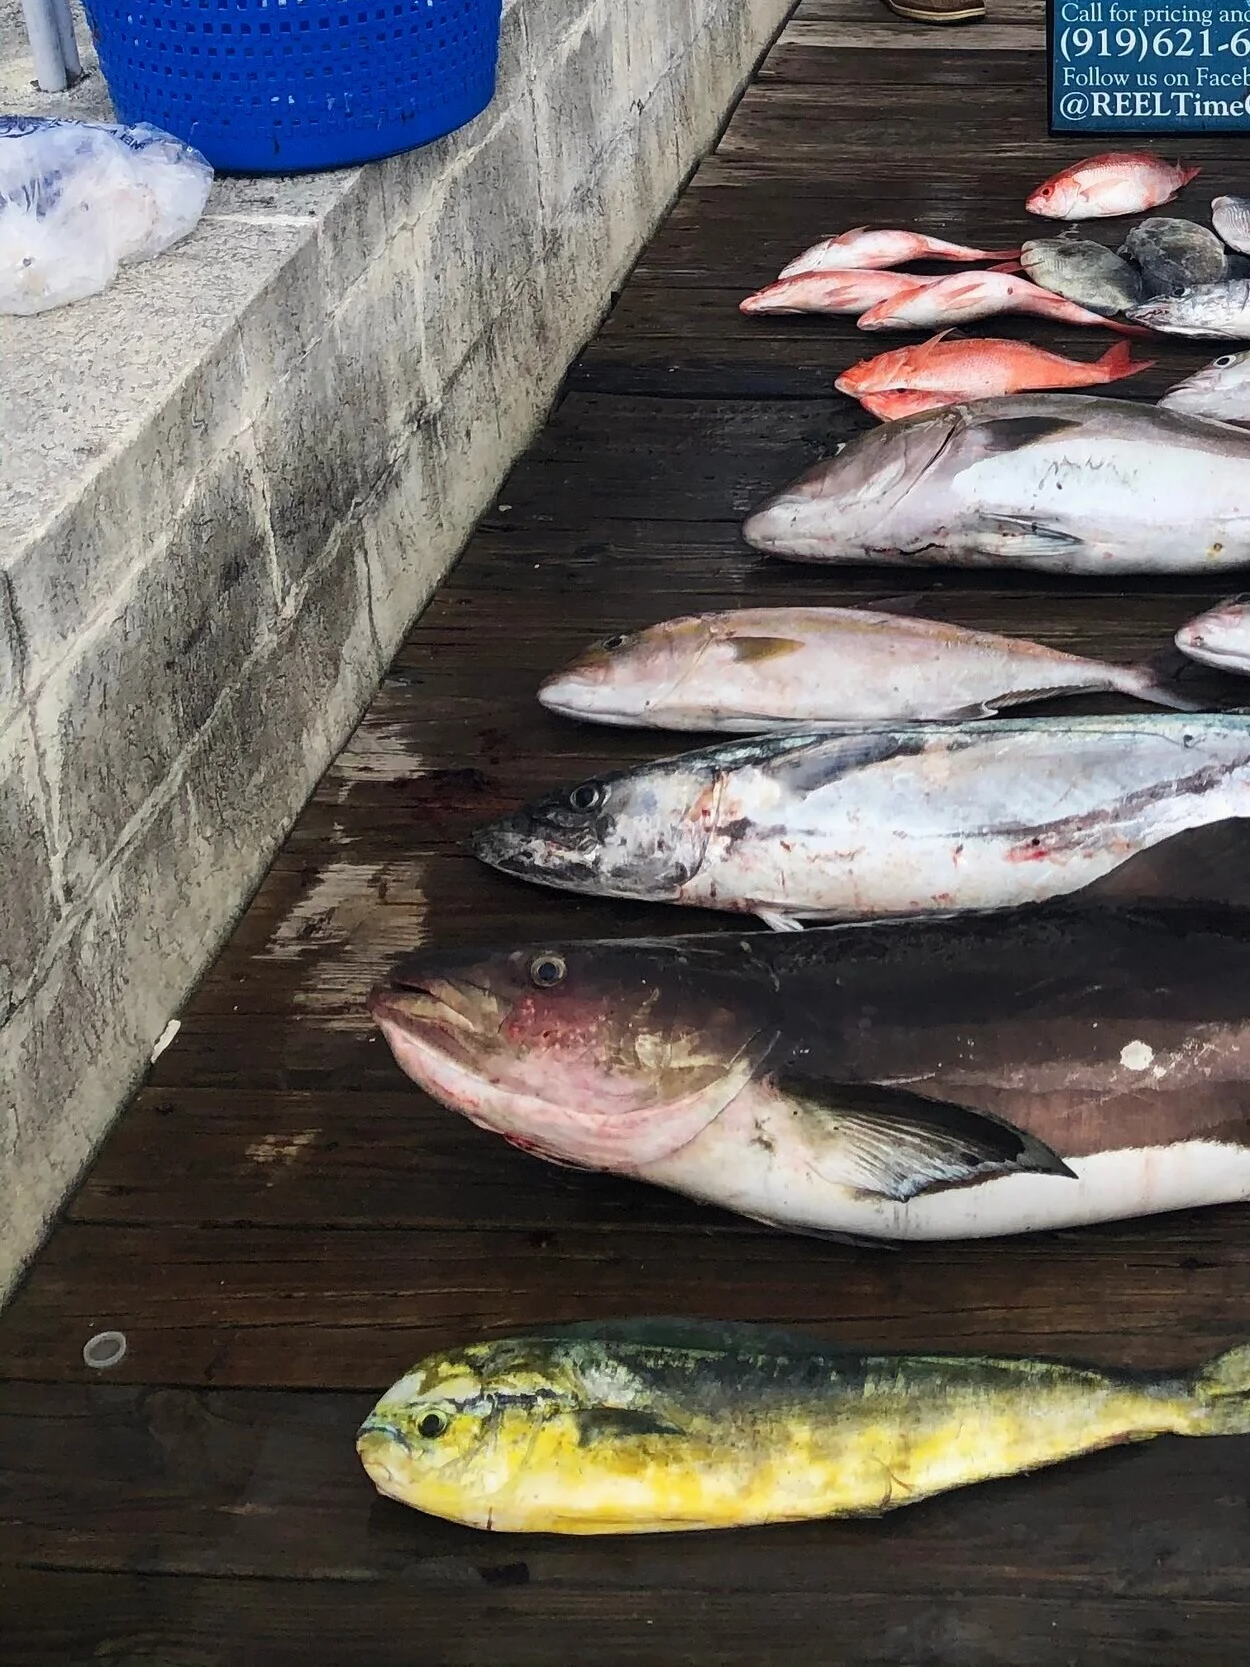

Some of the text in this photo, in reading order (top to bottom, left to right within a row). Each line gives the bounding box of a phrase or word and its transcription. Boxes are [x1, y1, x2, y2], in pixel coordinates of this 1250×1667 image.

[1061, 2, 1103, 23] Call
[1109, 2, 1137, 22] for
[1144, 5, 1213, 27] pricing
[1063, 66, 1130, 86] Follow
[1136, 73, 1158, 86] us
[1164, 73, 1189, 86] on
